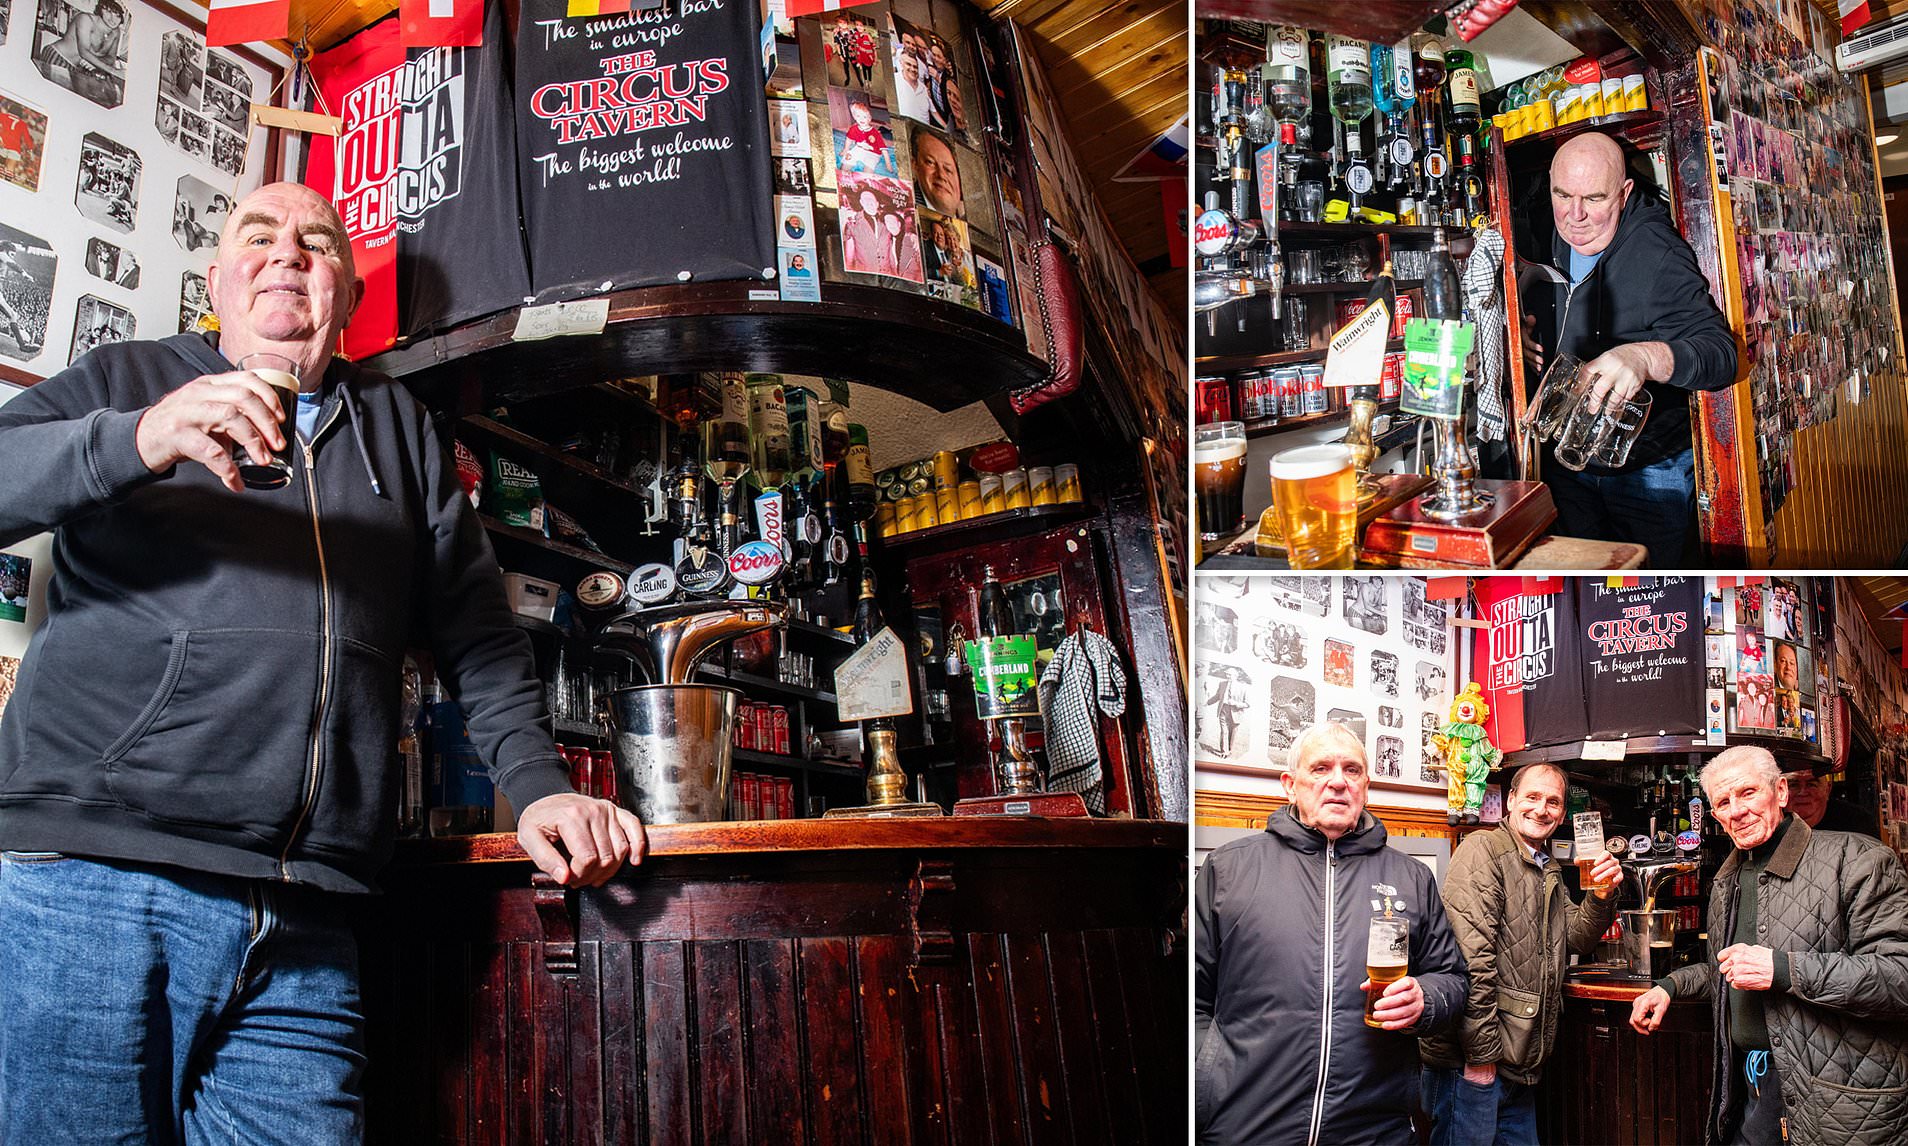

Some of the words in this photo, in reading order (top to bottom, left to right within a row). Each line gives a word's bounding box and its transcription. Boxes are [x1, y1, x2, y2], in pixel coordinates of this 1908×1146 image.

[534, 19, 578, 51] The
[585, 6, 673, 37] smallest
[681, 0, 724, 18] bar
[590, 39, 604, 50] in
[612, 23, 684, 47] europe
[1339, 40, 1366, 50] BACAR
[600, 50, 657, 76] THE
[348, 47, 453, 131] STRAIGHT
[530, 58, 730, 119] CIRCUS
[8, 115, 20, 130] 7
[551, 94, 709, 145] TAVERN
[342, 84, 456, 194] OUTTA
[533, 152, 572, 188] The
[579, 137, 645, 173] biggest
[651, 132, 734, 158] welcome
[588, 183, 597, 191] in
[599, 179, 611, 190] the
[618, 158, 681, 188] world!
[1262, 151, 1273, 211] Coors
[360, 155, 447, 231] CIRCUS
[345, 195, 359, 234] THE
[1195, 223, 1231, 243] Coors
[1332, 307, 1383, 352] Wainwright
[682, 569, 720, 582] GUINNESS
[729, 553, 783, 573] Coors
[633, 579, 668, 594] CARLING
[1590, 582, 1612, 602] The
[1629, 590, 1666, 604] europe
[1622, 605, 1651, 618] THE
[1493, 611, 1551, 663] OUTTA
[1588, 612, 1688, 641] CIRCUS
[1598, 633, 1677, 656] TAVERN
[1495, 663, 1503, 687] THE
[1503, 651, 1547, 685] CIRCUS
[1590, 660, 1609, 679] The
[1612, 655, 1645, 673] biggest
[1647, 652, 1688, 666] welcome
[1631, 667, 1662, 682] world!
[1676, 837, 1700, 846] Coors
